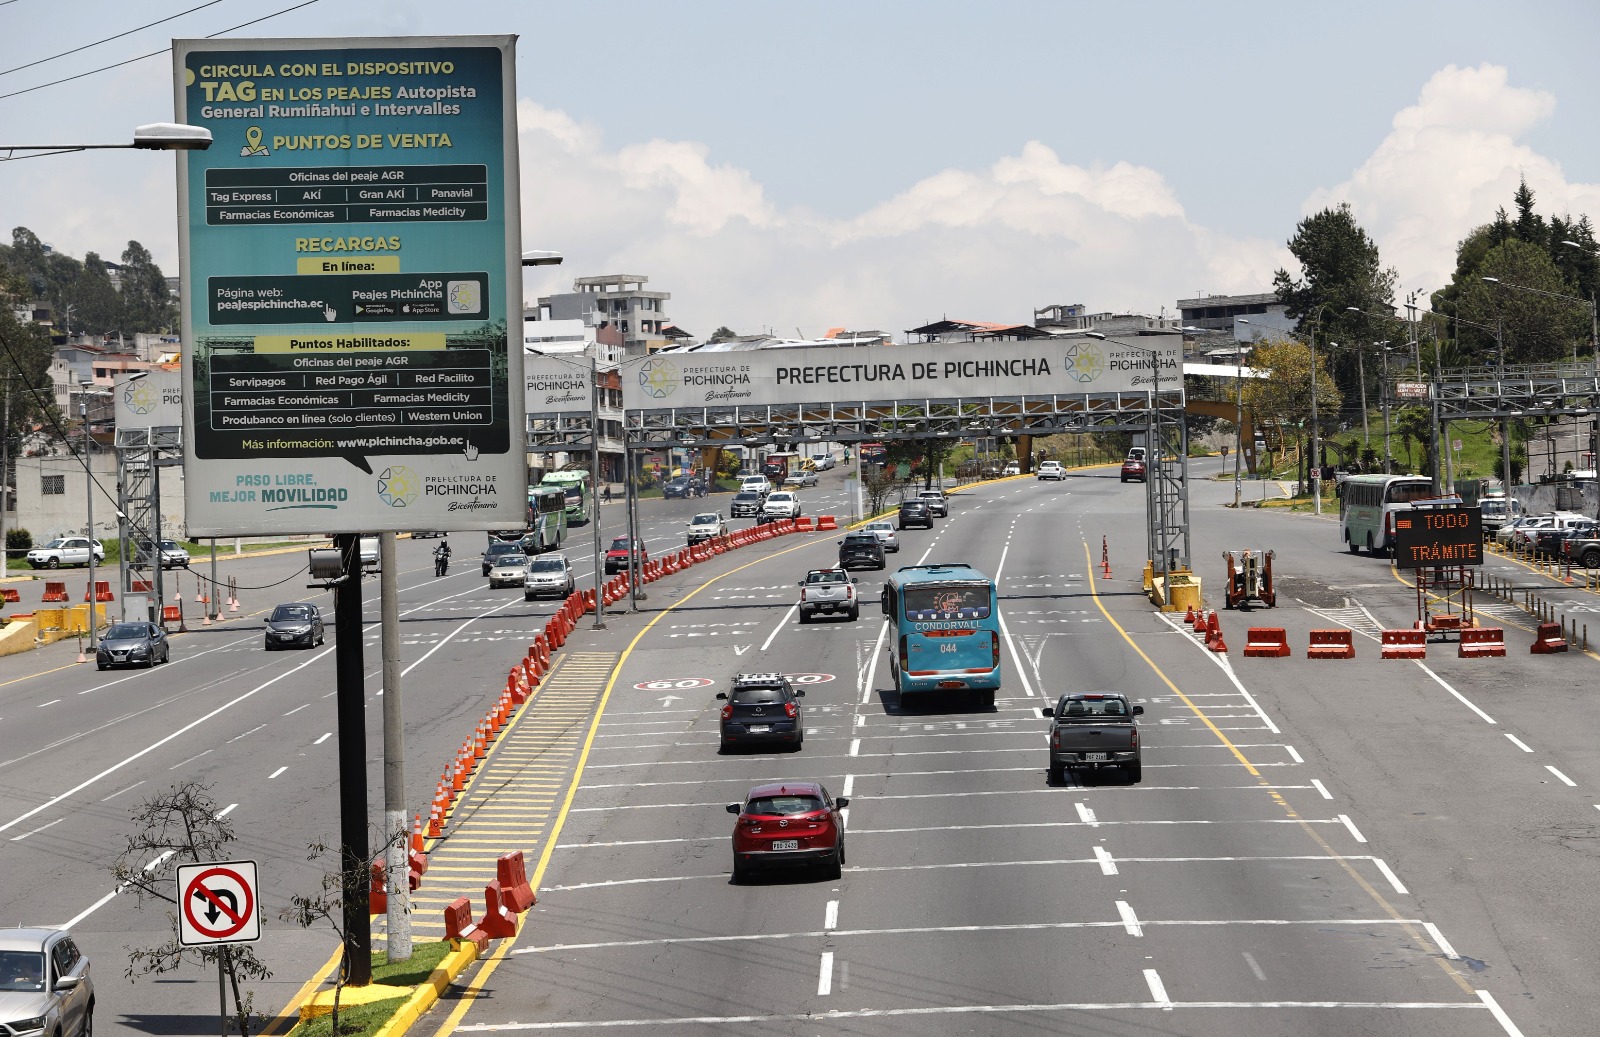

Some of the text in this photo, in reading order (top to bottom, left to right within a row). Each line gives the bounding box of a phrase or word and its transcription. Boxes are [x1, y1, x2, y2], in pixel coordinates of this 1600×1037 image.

[200, 61, 455, 79] CIRCULA CON EL DISPOSITIVO
[200, 81, 477, 103] TAG EN LOS PEAJES Autopista
[201, 102, 461, 119] General Rumiñahui e Intervalles
[273, 133, 453, 150] PUNTOS DE VENTA
[289, 171, 405, 183] Oficinas del peaje AGR
[211, 191, 272, 203] Tag Express
[302, 189, 322, 201] AKÍ
[359, 188, 405, 200] Gran AKÍ
[431, 188, 473, 199] Panavial
[219, 208, 335, 220] Farmacias Económicas
[369, 206, 466, 219] Farmacias Medicity
[295, 236, 401, 253] RECARGAS
[322, 260, 375, 272] En línea:
[419, 279, 443, 291] App
[217, 287, 283, 300] Página web:
[352, 288, 443, 302] Peajes Pichincha
[217, 299, 324, 312] peajespichincha.ec
[290, 337, 410, 350] Puntos Habilitados:
[1109, 350, 1163, 359] PREFECTUA
[293, 356, 409, 368] Oficinas del peaje AGR
[1110, 358, 1177, 371] PICHINCHA
[683, 366, 737, 374] PREFECTURA
[776, 357, 1051, 384] PREFECTURA DE PICHINCHA
[229, 377, 286, 390] Servipagos
[315, 372, 388, 387] Red Pago Ágil
[415, 372, 475, 383] Red Facilito
[684, 373, 751, 386] PICHINCHA
[527, 380, 585, 391] PICHINCHA
[373, 392, 470, 405] Farmacias Medicity
[545, 391, 586, 405] Bicentenario
[705, 385, 752, 402] Bicentenario
[224, 394, 339, 407] Farmacias Económicas
[222, 412, 396, 426] Produbanco en línea (solo clientes)
[408, 411, 483, 422] Western Union
[242, 435, 464, 450] Más información: www.pichincha.gob.ec
[236, 473, 317, 486] PASO LIBRE,
[209, 488, 348, 503] MEJOR MOVILIDAD
[425, 484, 497, 496] PICHINCHA
[447, 496, 498, 512] Bicentenario
[1424, 513, 1469, 530] TODO
[1410, 541, 1477, 561] TRÁMITE
[914, 620, 983, 631] CONDORVALL
[940, 644, 957, 654] 044
[646, 679, 700, 689] 60
